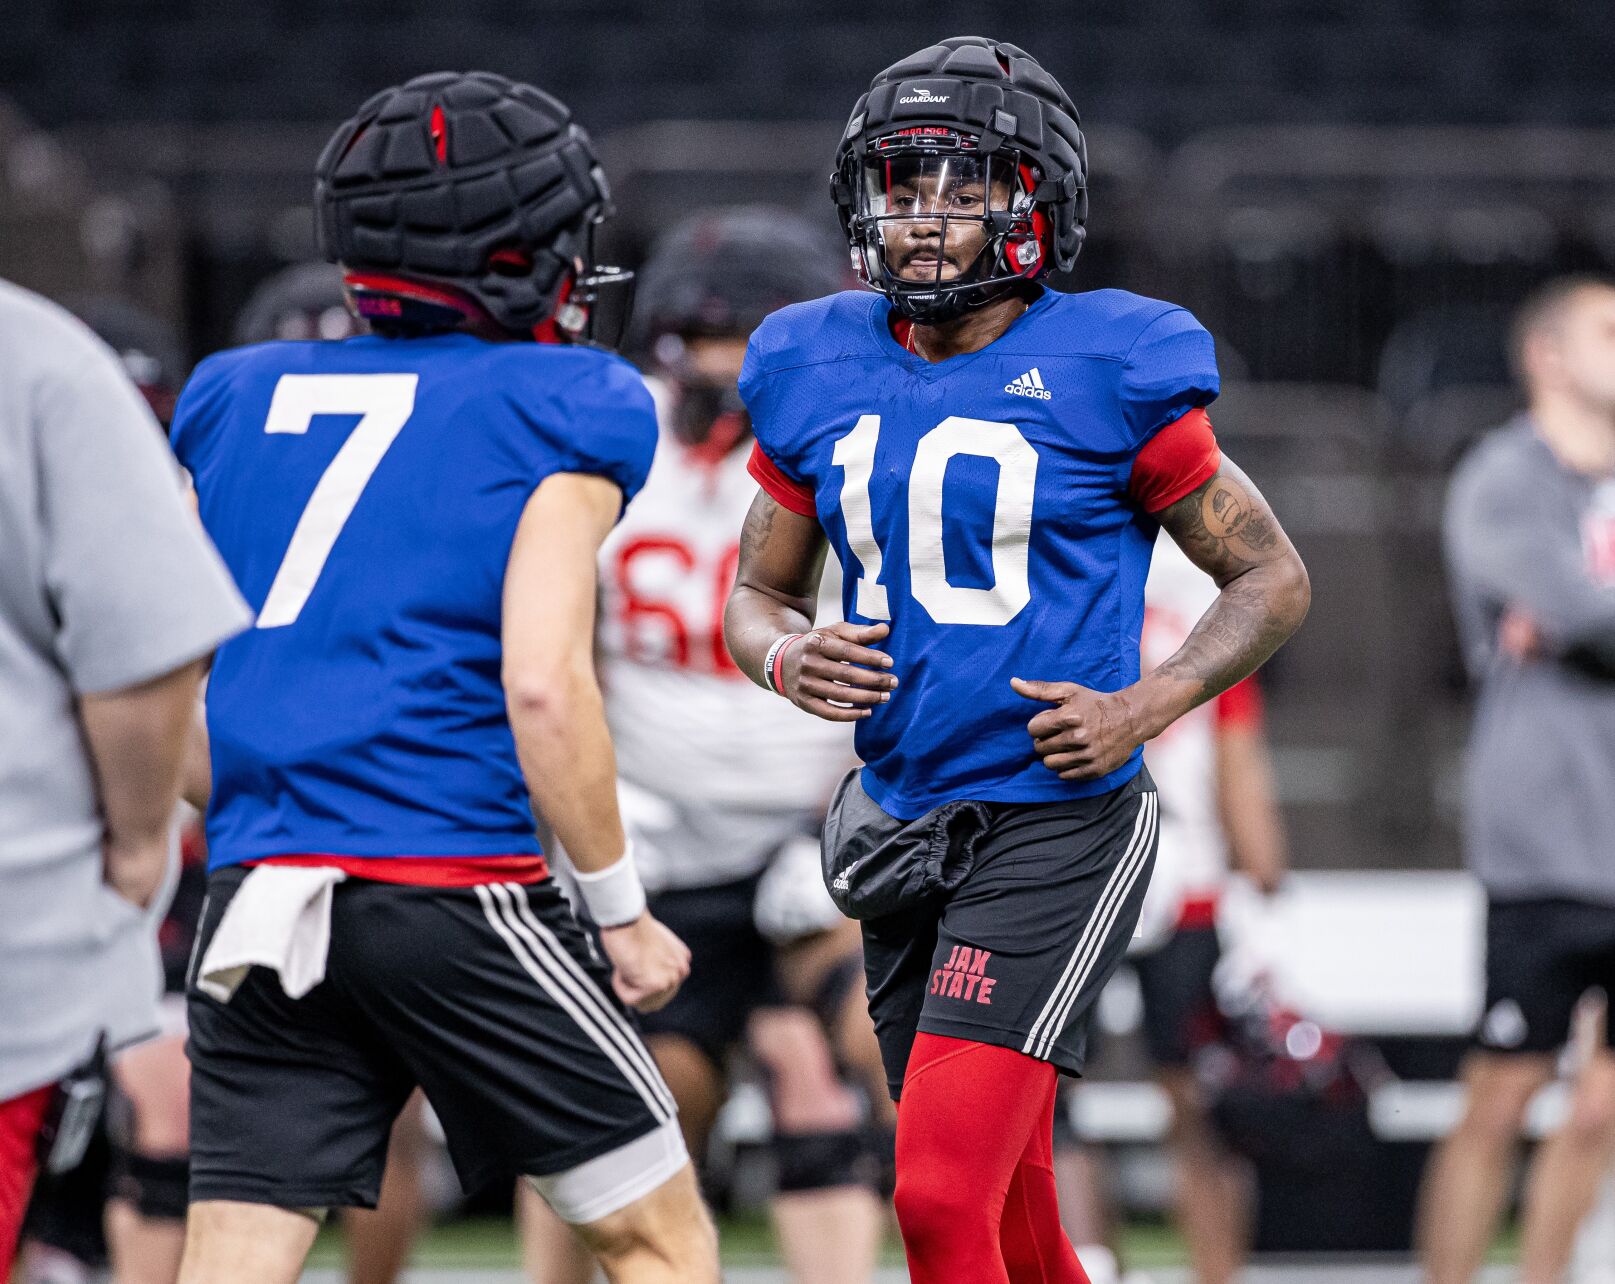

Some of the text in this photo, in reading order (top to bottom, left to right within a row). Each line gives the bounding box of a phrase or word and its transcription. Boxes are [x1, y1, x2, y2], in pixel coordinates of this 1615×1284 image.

[899, 95, 947, 104] GUARDIAN
[1004, 383, 1052, 401] adidas
[255, 373, 419, 629] 7
[831, 414, 1039, 626] 10
[943, 945, 992, 977] JAX
[930, 968, 997, 1005] STATE
